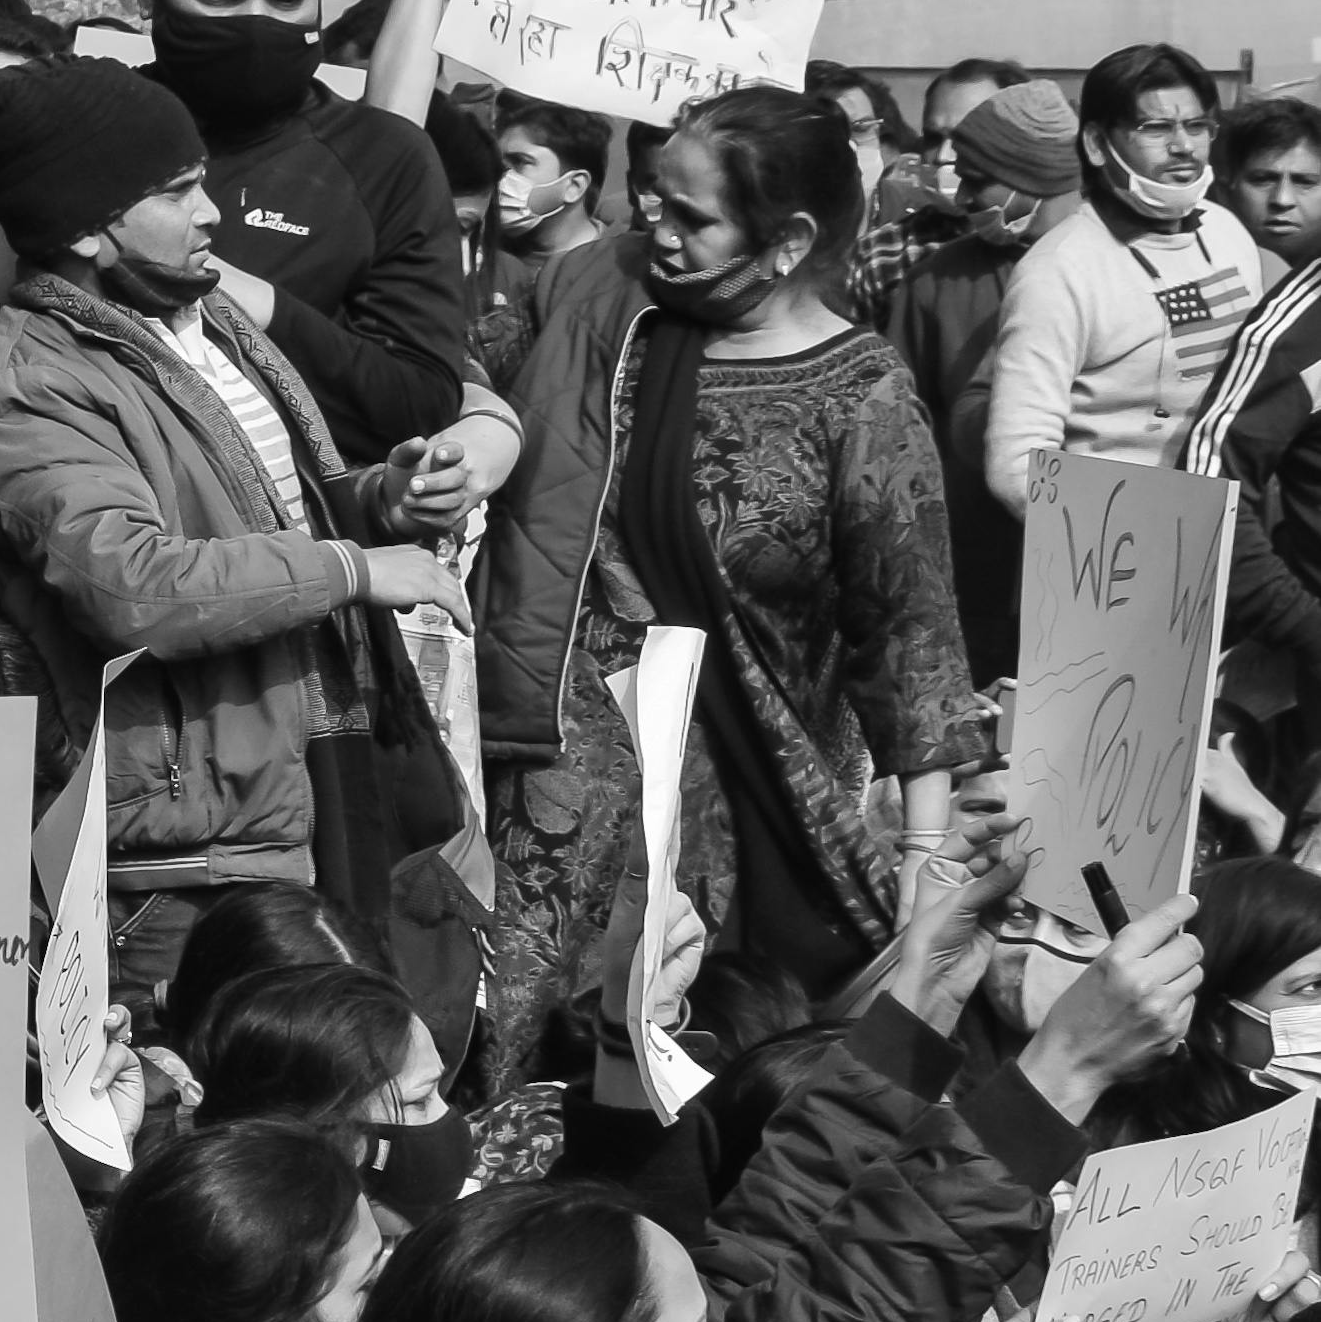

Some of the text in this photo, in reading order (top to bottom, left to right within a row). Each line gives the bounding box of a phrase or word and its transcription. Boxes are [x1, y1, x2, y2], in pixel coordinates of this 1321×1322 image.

[1061, 479, 1137, 612] WE
[1066, 1166, 1142, 1231] ALL
[1152, 1148, 1246, 1208] NSQF
[1054, 1244, 1163, 1296] TRAINERS
[1164, 1277, 1199, 1318] IN
[1211, 1260, 1255, 1303] THE
